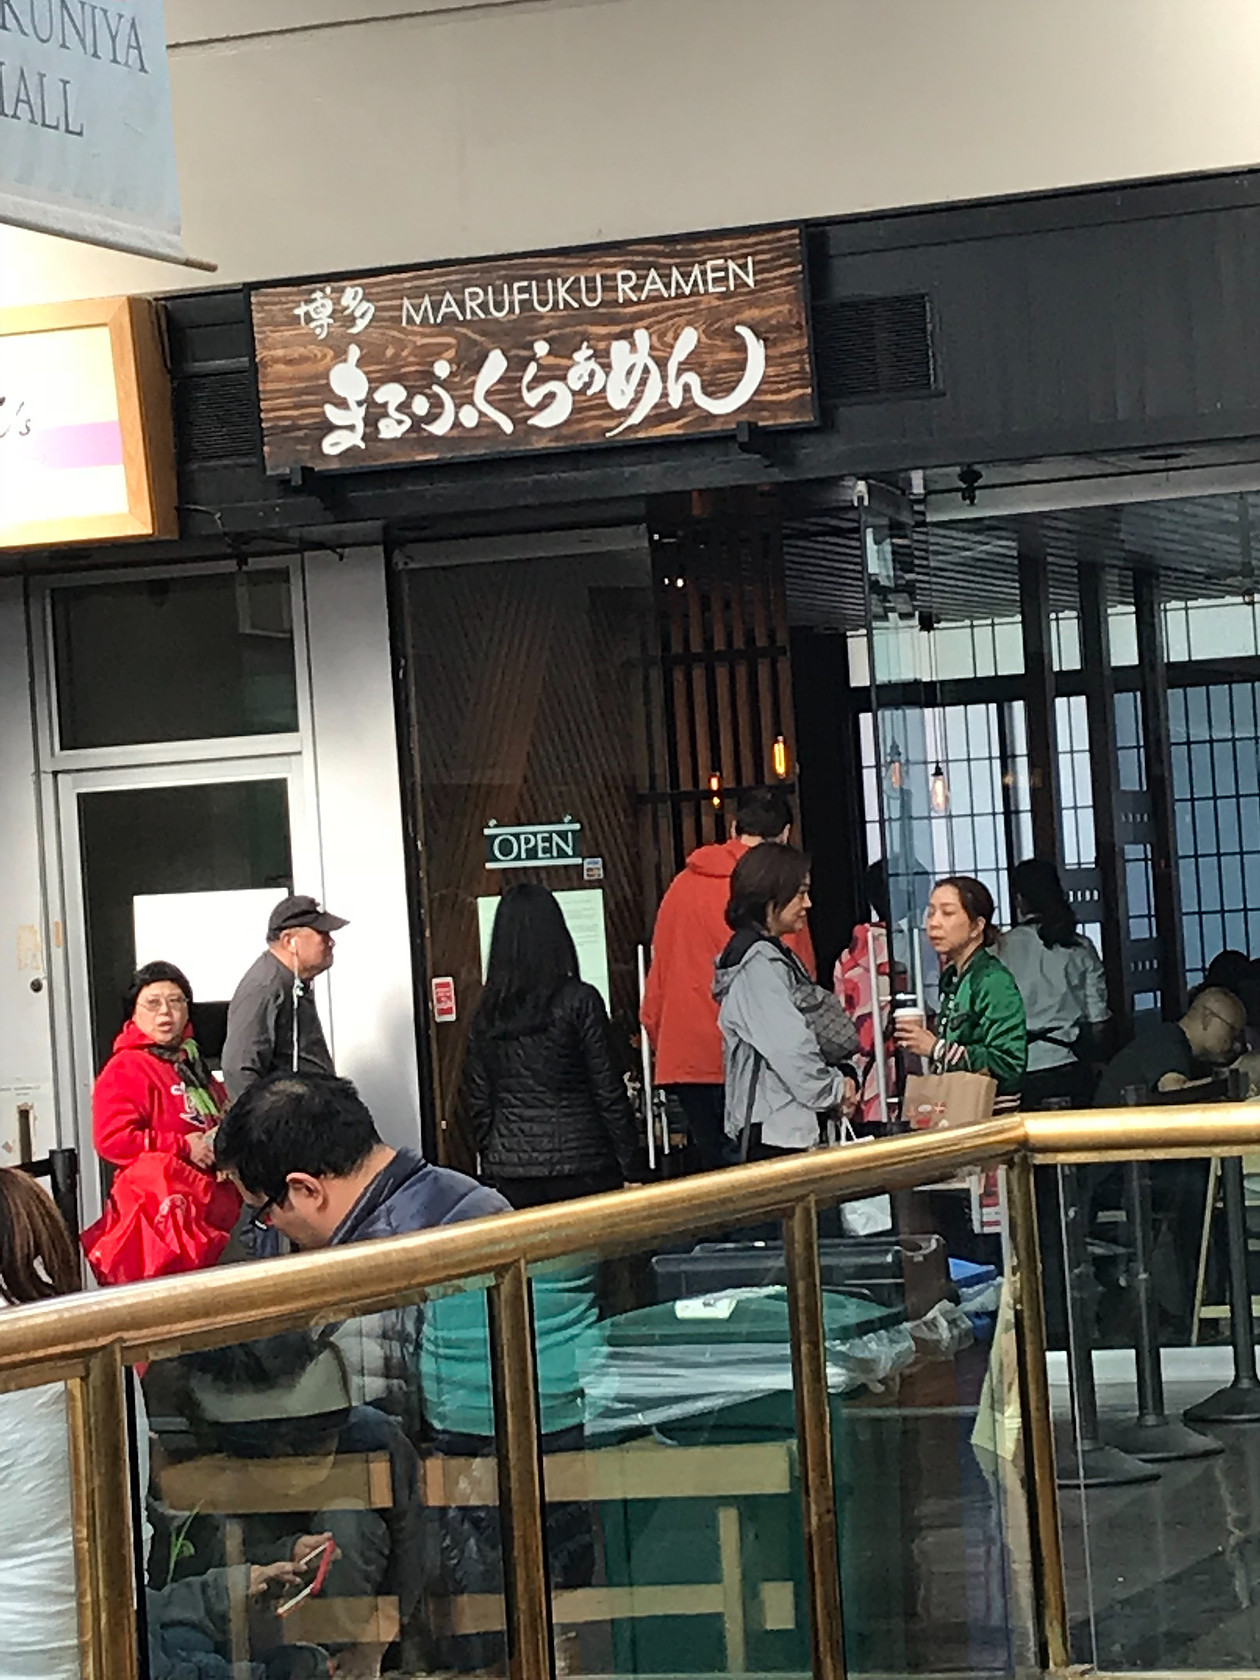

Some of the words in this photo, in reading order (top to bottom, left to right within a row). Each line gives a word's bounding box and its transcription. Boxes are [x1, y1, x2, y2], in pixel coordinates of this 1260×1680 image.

[0, 61, 84, 137] ALL
[293, 285, 375, 340] 博多
[401, 272, 602, 327] MARUFUKU
[616, 255, 755, 304] RAMEN
[492, 831, 574, 861] OPEN
